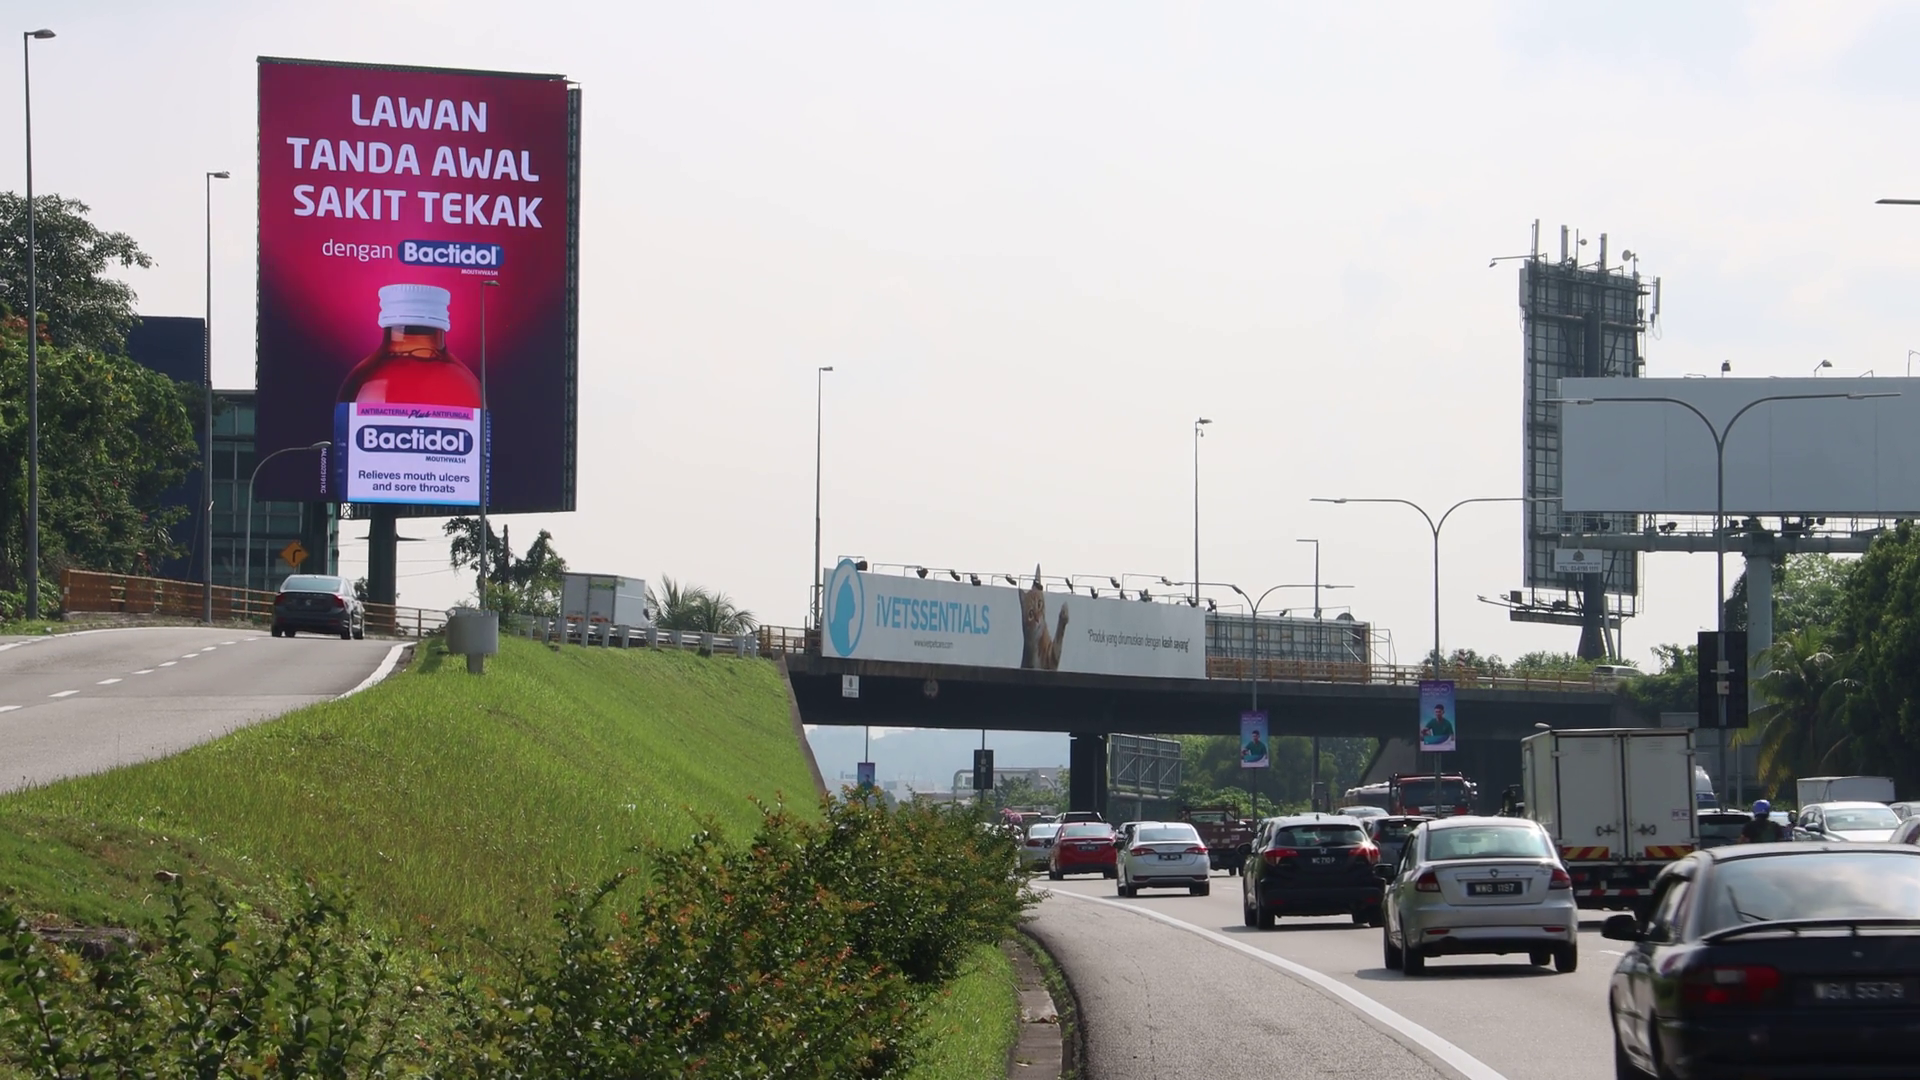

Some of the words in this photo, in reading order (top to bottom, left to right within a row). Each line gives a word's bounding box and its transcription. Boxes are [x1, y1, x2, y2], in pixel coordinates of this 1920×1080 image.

[352, 94, 487, 133] LAWAN
[286, 137, 420, 175] TANDA
[431, 146, 539, 181] AWAL
[293, 185, 406, 221] SAKIT
[417, 191, 543, 228] TEKAK
[322, 238, 393, 262] dengan
[404, 242, 498, 265] Bactidol
[360, 408, 409, 417] ANTIBACTERIAL
[431, 411, 471, 420] ANTIFUNGAL
[363, 428, 465, 452] Bactidol
[425, 456, 466, 464] MOUTHWASH
[358, 470, 400, 480] Relieves
[403, 472, 436, 482] mouth
[438, 473, 470, 483] ulcers
[372, 482, 391, 491] and
[394, 484, 417, 492] sore
[419, 483, 455, 494] throats
[876, 594, 990, 635] iVETSSENTIALS
